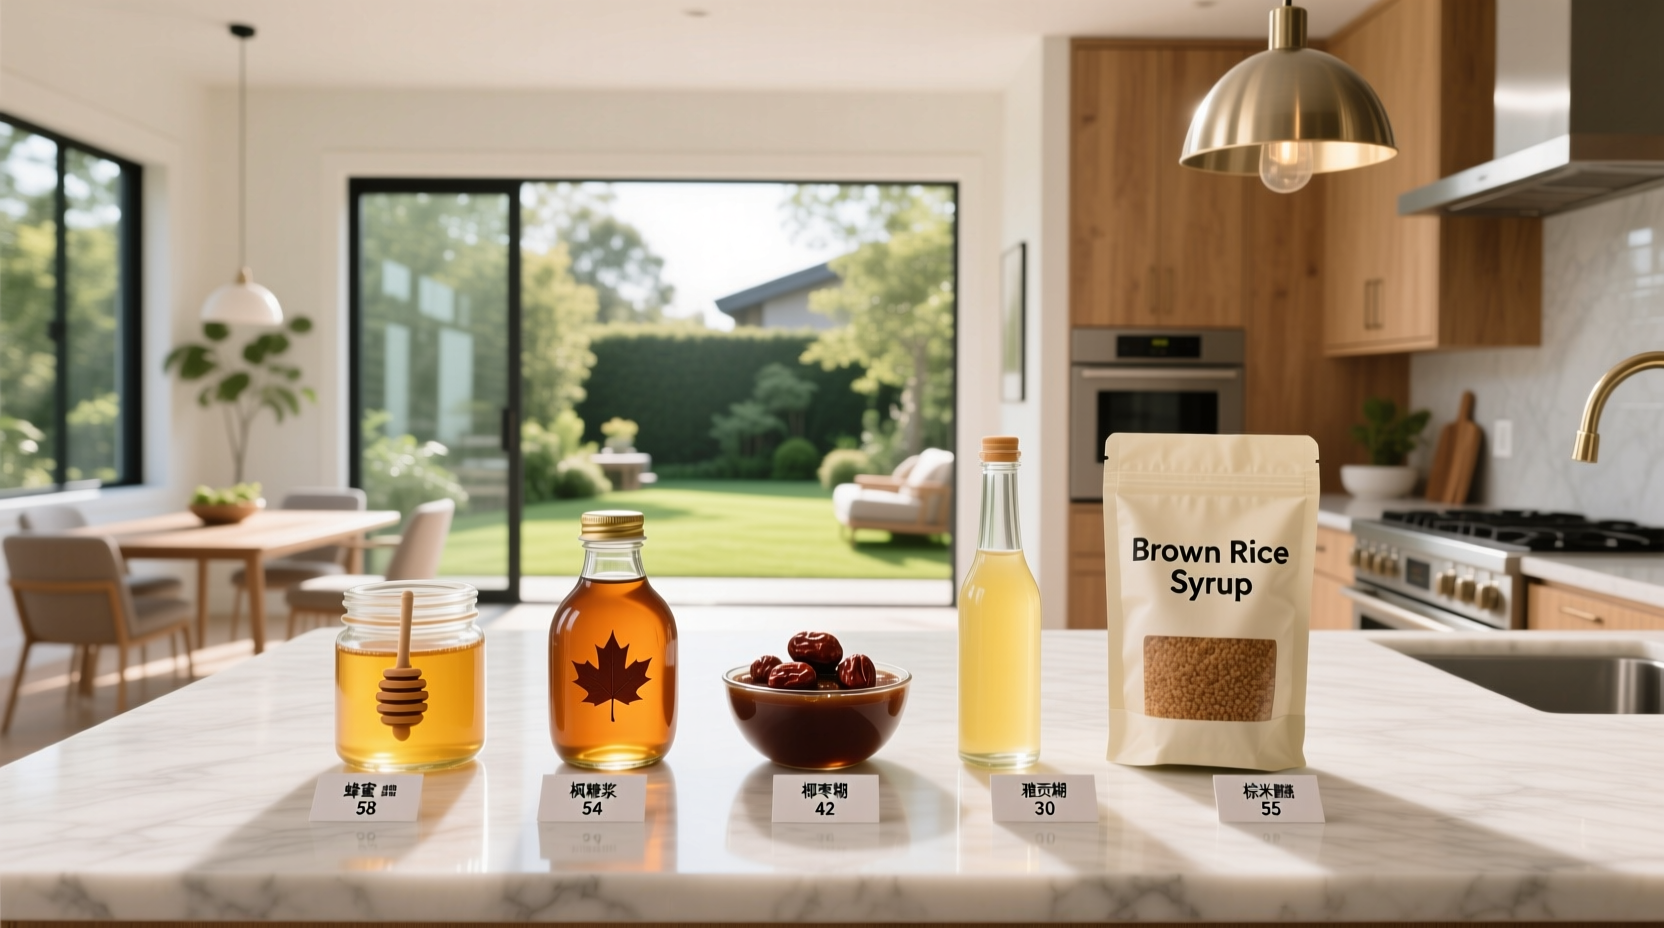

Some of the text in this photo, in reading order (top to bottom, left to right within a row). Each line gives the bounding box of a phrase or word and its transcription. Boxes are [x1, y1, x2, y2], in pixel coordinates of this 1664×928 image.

[1132, 537, 1289, 565] Brown Rice
[1171, 569, 1253, 602] Syrup
[356, 801, 377, 815] 58
[582, 801, 603, 815] 54
[815, 801, 835, 815] 42
[1035, 801, 1055, 815] 30
[1261, 801, 1281, 816] 55
